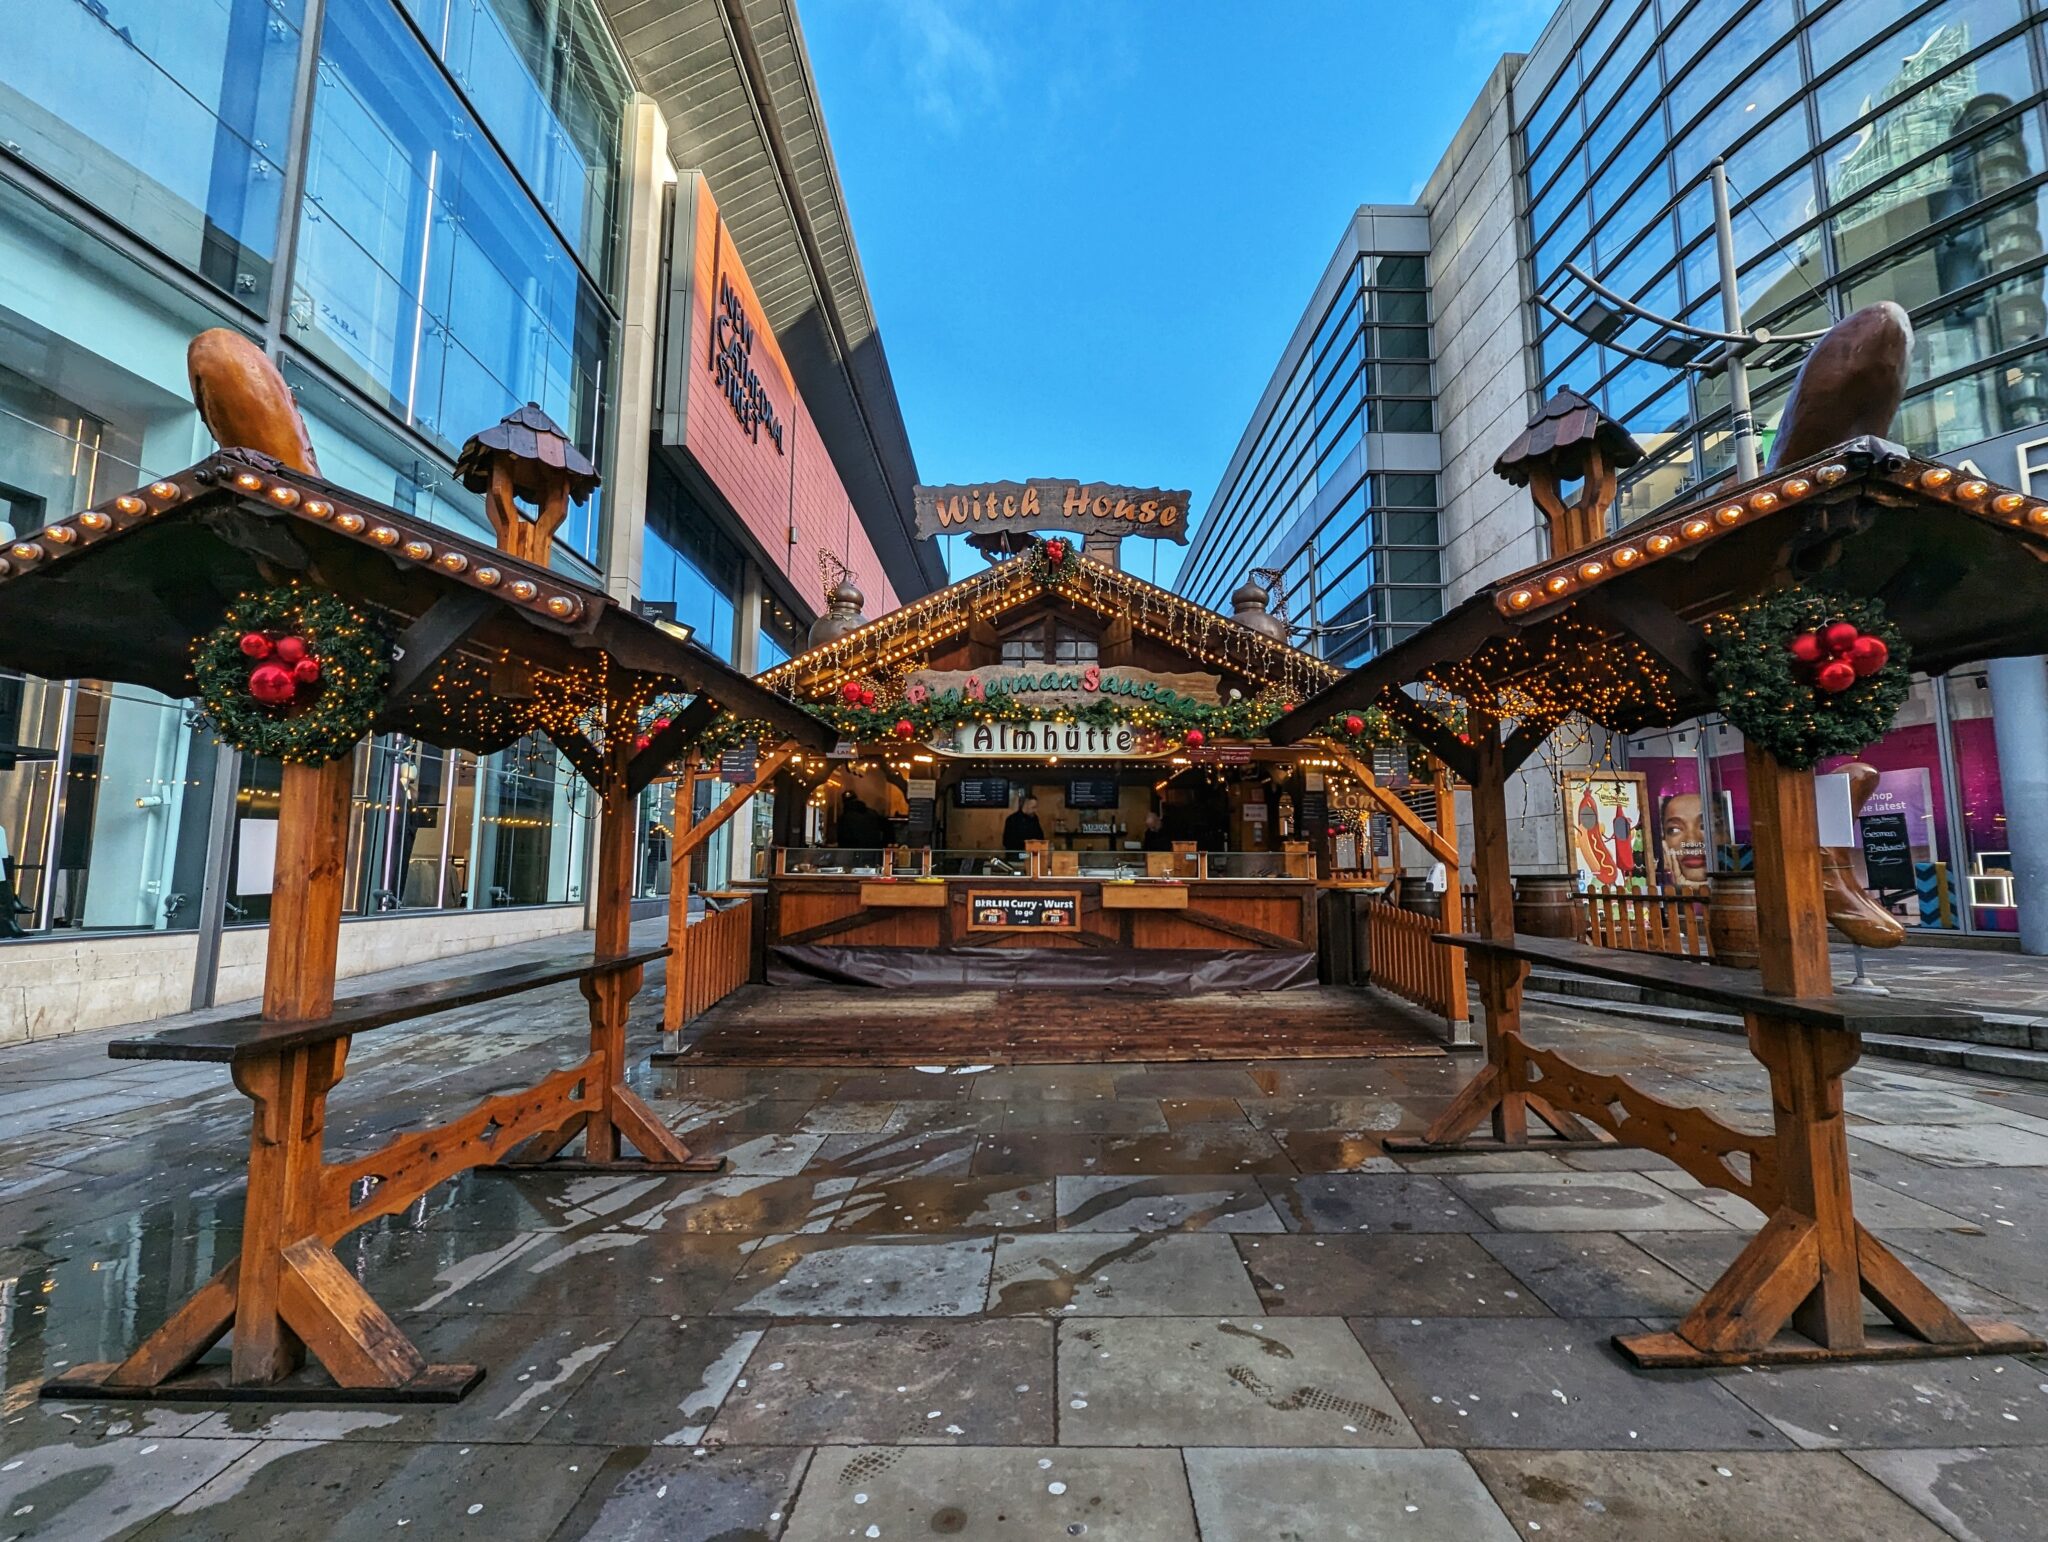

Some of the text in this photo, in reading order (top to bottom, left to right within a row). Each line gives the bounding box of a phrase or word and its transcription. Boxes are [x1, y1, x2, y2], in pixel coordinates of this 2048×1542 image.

[321, 304, 358, 340] ZARA
[721, 271, 753, 355] NEW
[716, 352, 762, 444] STREET
[718, 314, 784, 456] CATHEDRAL
[936, 486, 1178, 528] Witch House
[965, 671, 1079, 703] German
[973, 723, 1133, 752] Almhütte
[1875, 801, 1907, 812] latest
[1010, 899, 1037, 910] Curry
[1044, 900, 1074, 909] Wurst
[1024, 910, 1034, 918] go
